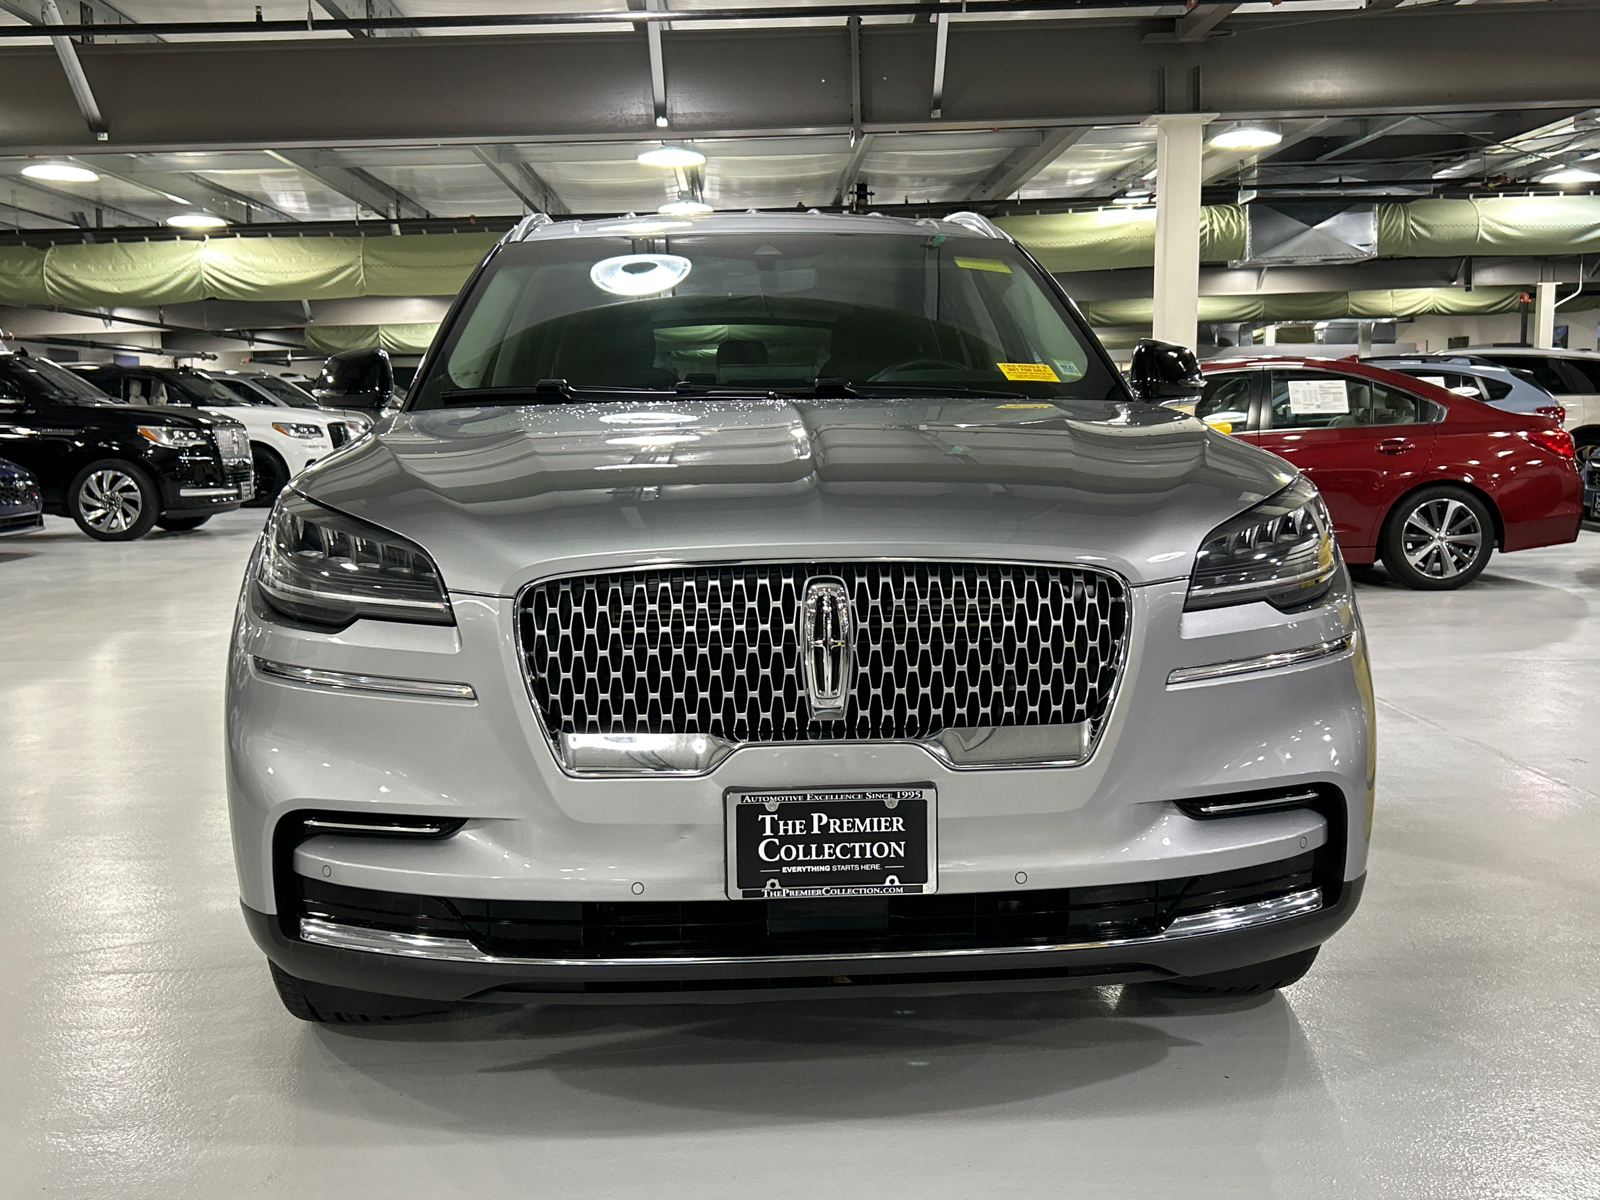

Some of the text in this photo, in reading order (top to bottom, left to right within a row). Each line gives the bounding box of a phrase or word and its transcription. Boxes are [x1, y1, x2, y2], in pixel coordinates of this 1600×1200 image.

[896, 790, 921, 799] 1995
[758, 812, 906, 836] THE PREMIER
[757, 838, 906, 862] COLLECTION
[781, 865, 831, 873] EVERYTHING
[860, 863, 883, 871] HERE.
